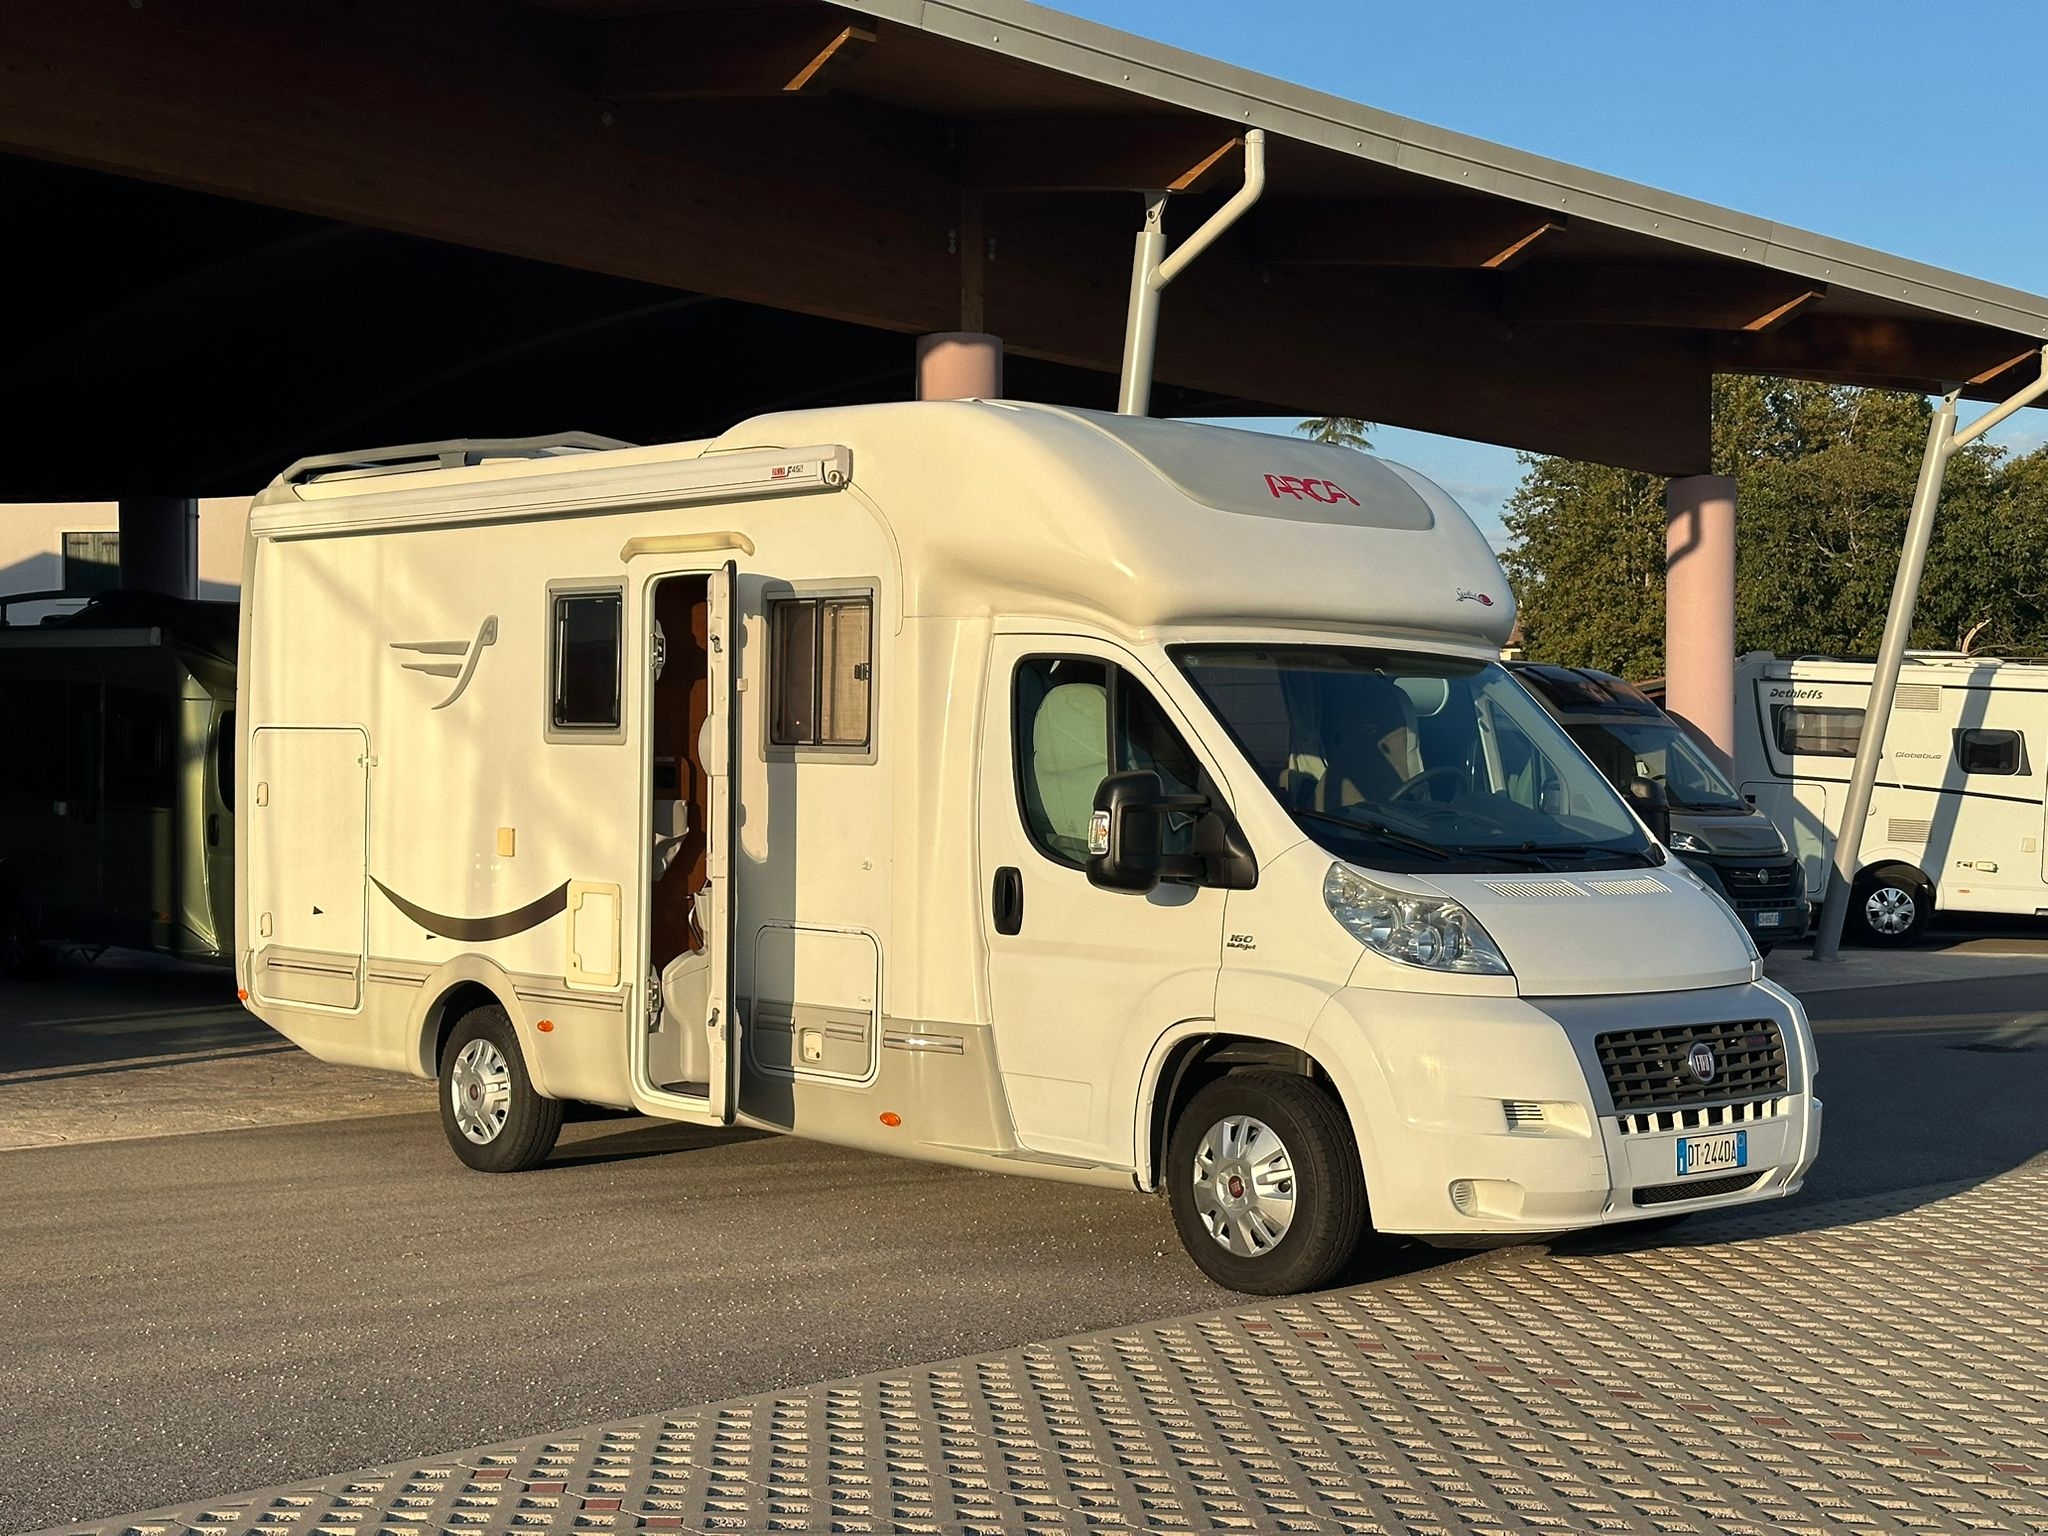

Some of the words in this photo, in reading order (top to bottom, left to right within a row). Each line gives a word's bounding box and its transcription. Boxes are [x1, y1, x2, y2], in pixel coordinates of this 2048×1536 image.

[1263, 474, 1361, 507] ARCA
[1769, 688, 1823, 700] Dethleffs
[1230, 934, 1254, 943] 160
[1704, 1140, 1737, 1165] 244DA
